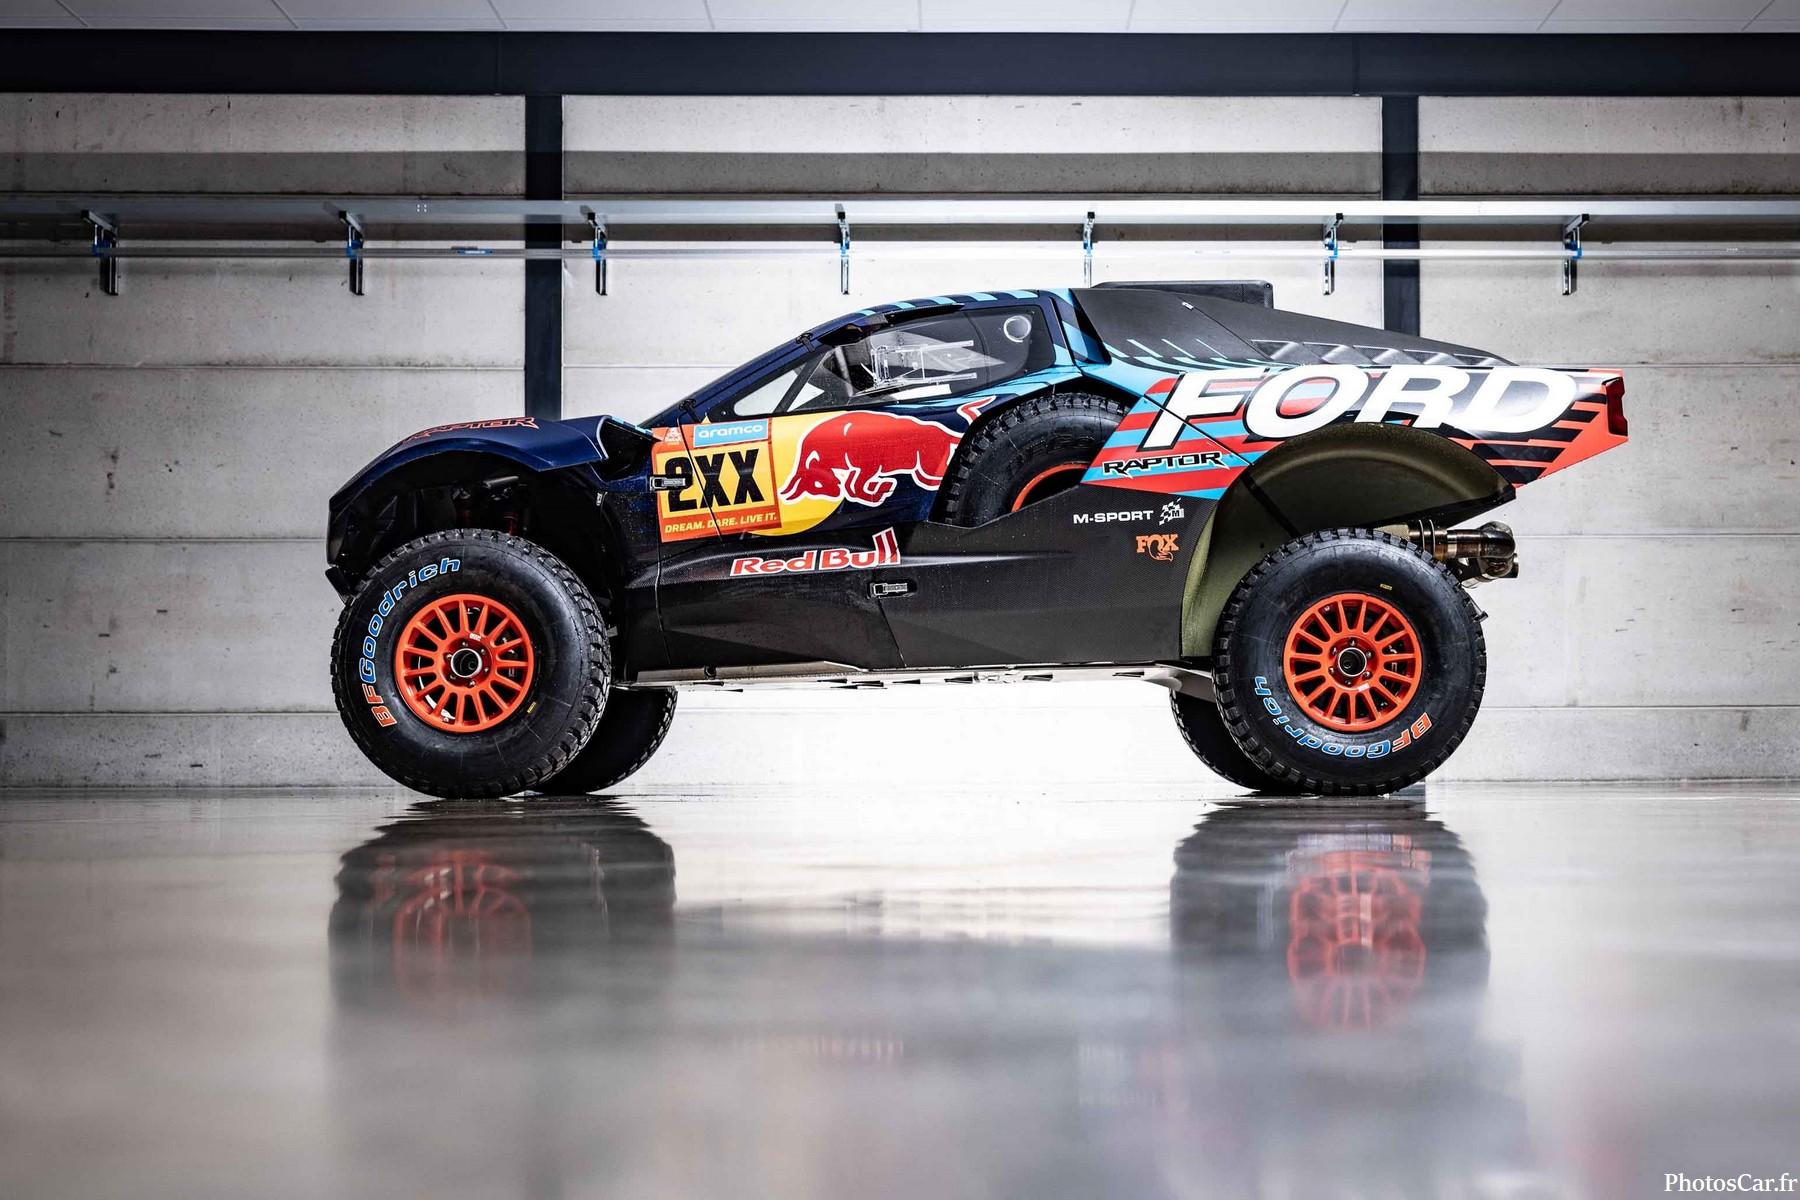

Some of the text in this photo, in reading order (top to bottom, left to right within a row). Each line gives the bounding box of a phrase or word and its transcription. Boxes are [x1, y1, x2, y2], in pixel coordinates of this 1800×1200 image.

[1139, 363, 1578, 450] FORD
[698, 425, 764, 439] aramco
[664, 448, 765, 512] 2XX
[1102, 451, 1230, 479] RAPTOR
[664, 520, 705, 534] DREAM.
[740, 513, 763, 525] LIVE
[1073, 510, 1154, 524] M-SPORT
[730, 527, 901, 577] Red Bull
[1136, 533, 1180, 562] FOX
[359, 557, 461, 728] BFGoodrich
[1254, 676, 1433, 759] BFGoodrich
